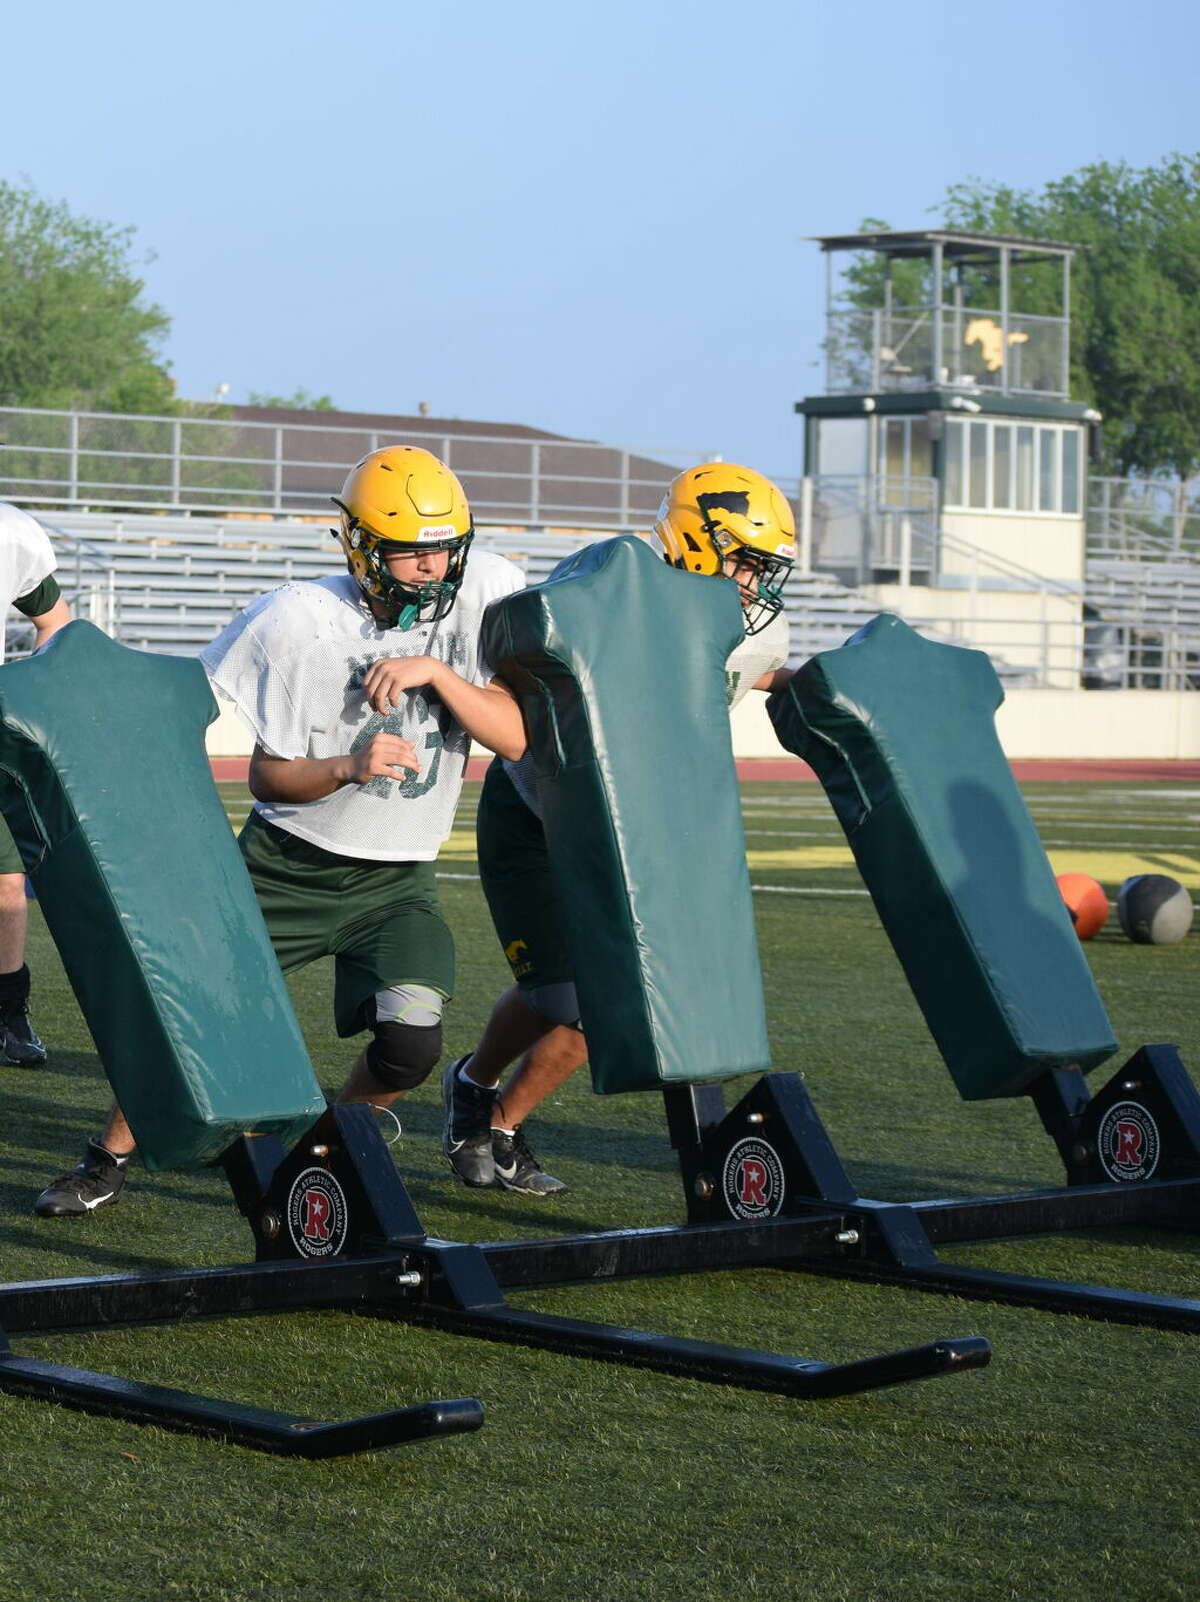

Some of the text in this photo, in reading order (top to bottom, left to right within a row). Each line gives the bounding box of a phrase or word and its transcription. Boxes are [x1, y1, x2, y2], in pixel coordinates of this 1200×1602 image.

[423, 527, 453, 538] Riddell
[1116, 1121, 1143, 1166] R
[740, 1158, 767, 1207] R
[304, 1189, 330, 1241] R
[299, 1236, 334, 1256] ROGERS
